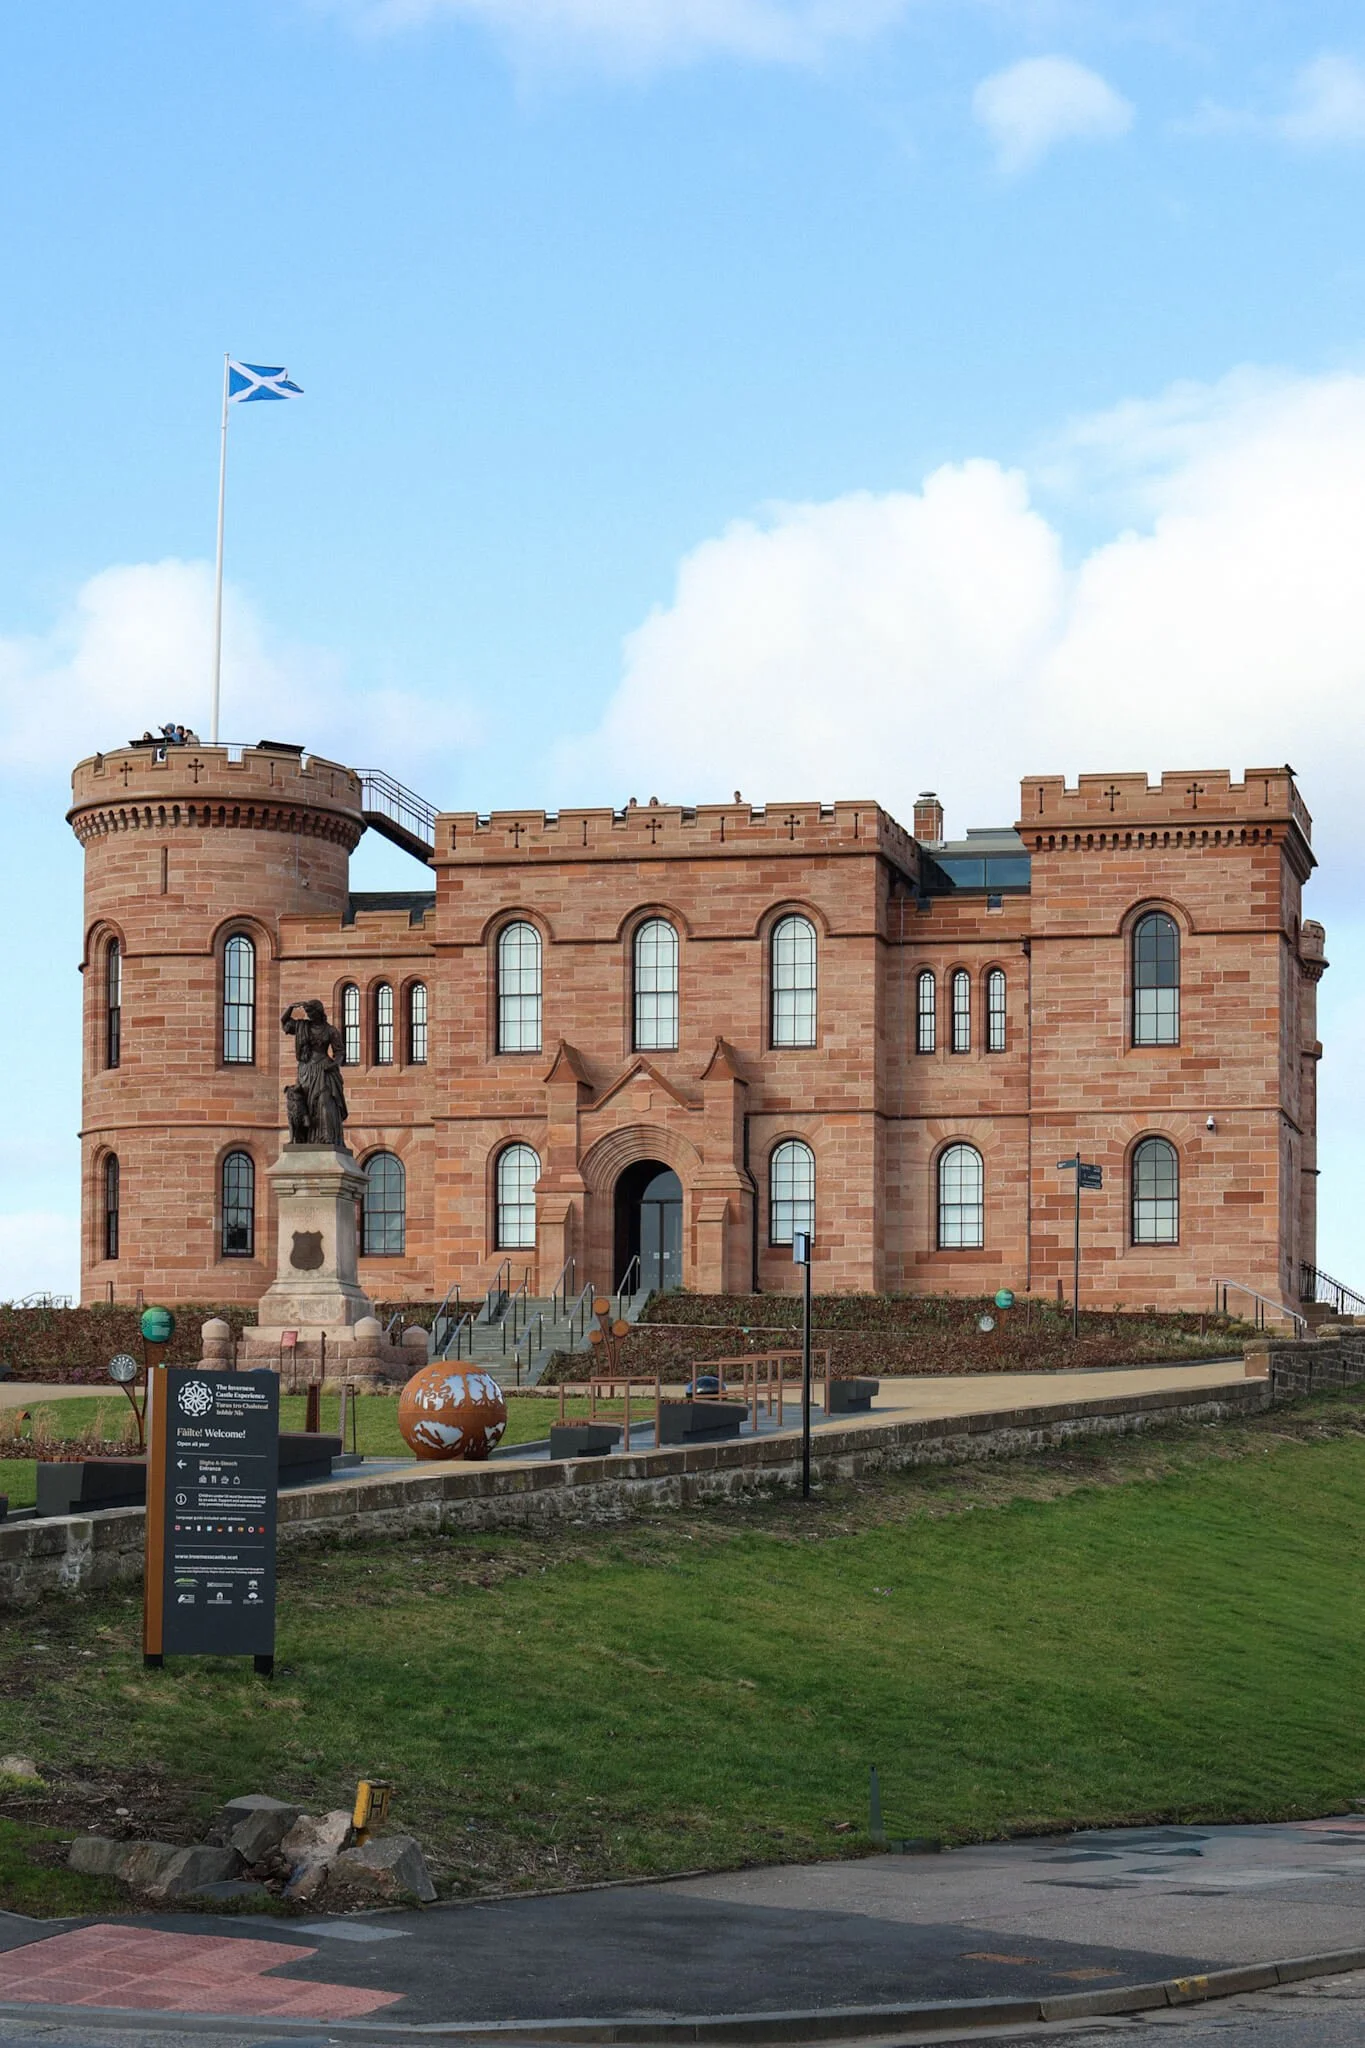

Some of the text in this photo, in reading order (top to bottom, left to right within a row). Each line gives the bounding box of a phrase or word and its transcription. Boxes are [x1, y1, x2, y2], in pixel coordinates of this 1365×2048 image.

[228, 1384, 255, 1392] Inverness
[234, 1392, 265, 1400] Experience
[177, 1427, 246, 1439] Fàilte! Welcome!
[370, 1791, 385, 1817] H
